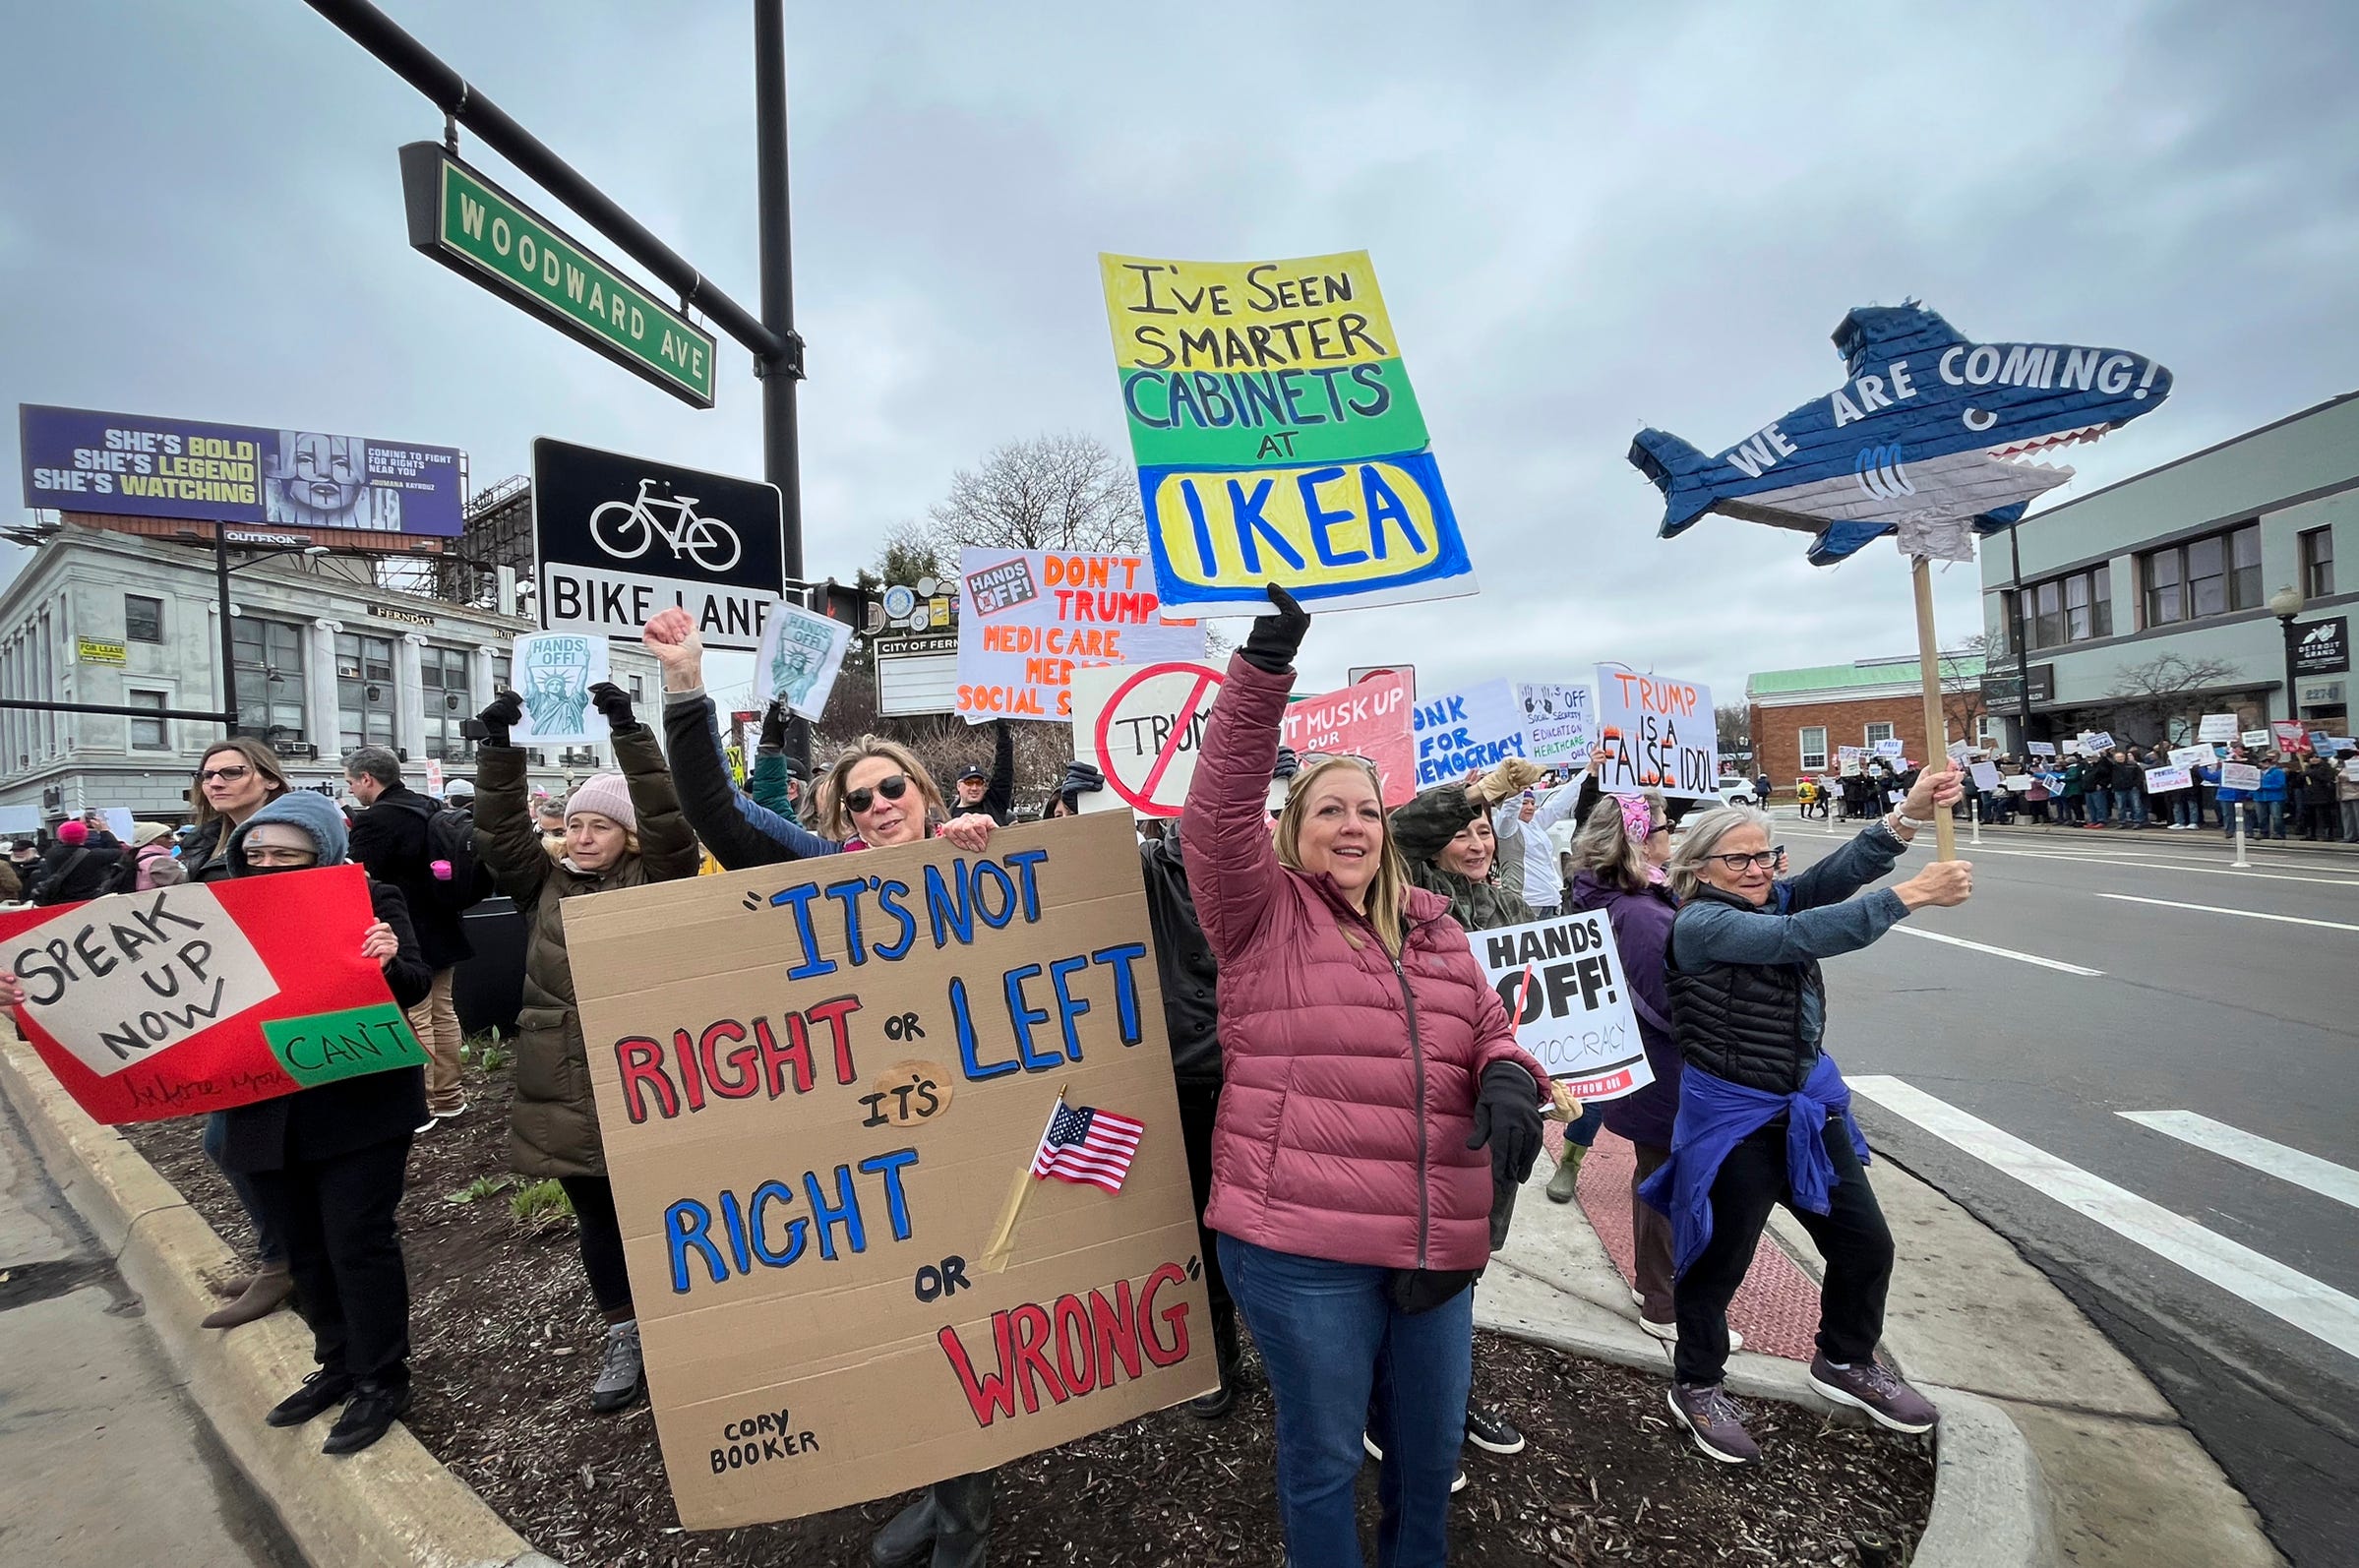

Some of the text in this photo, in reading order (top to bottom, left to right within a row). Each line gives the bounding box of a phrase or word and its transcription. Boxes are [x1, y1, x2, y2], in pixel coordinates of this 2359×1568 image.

[460, 192, 702, 379] WOODWARD AVE
[1122, 264, 1352, 315] I'VE SEEN
[1134, 314, 1389, 369] SMARTER
[1124, 362, 1390, 429] CABINETS
[1725, 344, 2159, 478] WE ARE COMING!
[104, 429, 254, 461] SHE'S BOLD
[368, 448, 453, 464] COMING TO FIGHT
[368, 456, 425, 469] FOR RIGHTS
[1256, 431, 1300, 459] AT
[74, 449, 255, 482] SHE'S LEGEND
[369, 464, 416, 477] NEAR YOU
[33, 468, 256, 505] SHE'S WATCHING
[1180, 464, 1427, 577] IKEA
[971, 562, 1026, 592] HANDS
[1044, 555, 1141, 589] DON'T
[553, 575, 654, 626] BIKE
[790, 615, 831, 639] HANDS
[984, 625, 1126, 661] MEDICARE,
[99, 645, 124, 654] LEASE
[532, 638, 584, 654] HANDS
[542, 651, 575, 666] OFF!
[881, 642, 908, 652] CITY
[910, 641, 928, 650] OF
[2298, 641, 2340, 653] DETROIT
[2304, 649, 2336, 658] GRAND
[956, 685, 1045, 715] SOCIAL
[1306, 696, 1368, 736] MUSK
[1373, 688, 1404, 716] UP
[1564, 690, 1586, 708] OFF
[1614, 673, 1697, 717] TRUMP
[1307, 731, 1340, 751] OUR
[1420, 727, 1477, 759] FOR
[1533, 724, 1582, 742] EDUCATION
[1534, 735, 1586, 758] HEALTHCARE
[1641, 715, 1678, 746] IS A
[1602, 733, 1720, 794] FALSE IDOL
[923, 848, 1049, 949] NOT
[14, 890, 205, 1006] SPEAK
[1486, 918, 1603, 969] HANDS
[141, 939, 212, 997] UP
[1496, 953, 1617, 1025] OFF!
[98, 976, 225, 1060] NOW
[613, 941, 1148, 1125] RIGHT OR LEFT
[285, 1020, 409, 1071] CAN'T
[857, 1073, 939, 1129] IT'S
[665, 1147, 919, 1296] RIGHT
[913, 1255, 972, 1303] OR
[724, 1409, 790, 1442] CORY
[710, 1429, 819, 1476] BOOKER
